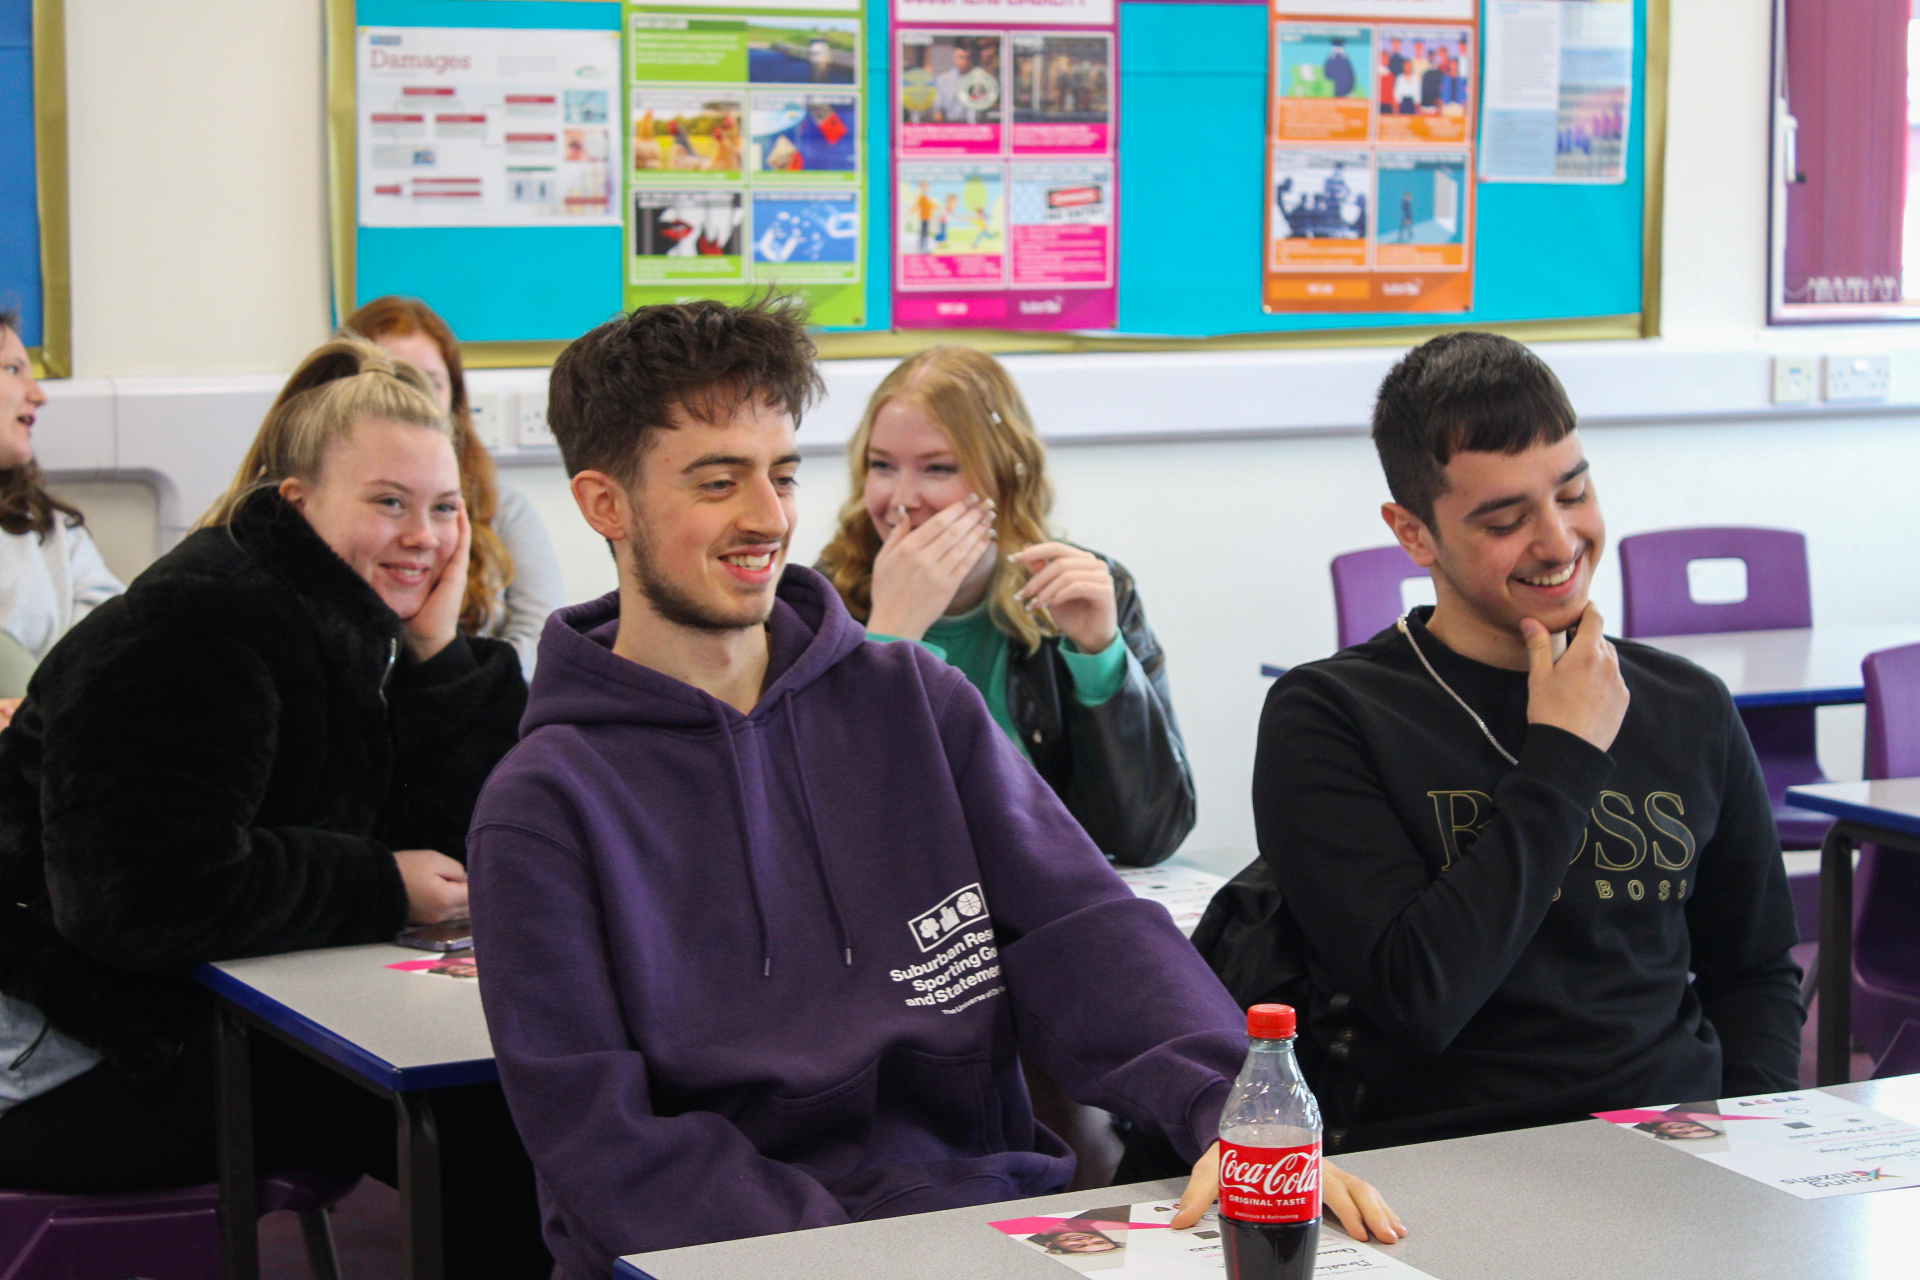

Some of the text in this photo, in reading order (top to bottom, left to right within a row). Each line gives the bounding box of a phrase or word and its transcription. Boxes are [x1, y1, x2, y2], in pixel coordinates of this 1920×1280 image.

[370, 49, 471, 73] Damages
[1427, 790, 1696, 871] BSS
[1595, 879, 1687, 901] BOSS
[890, 928, 995, 982] Suburban Res
[912, 954, 982, 991] Sporting
[904, 992, 936, 1007] and
[1219, 1148, 1319, 1195] Coca-Cola
[1228, 1194, 1307, 1207] ORIGINAL TASTE
[1234, 1211, 1260, 1219] Delicious
